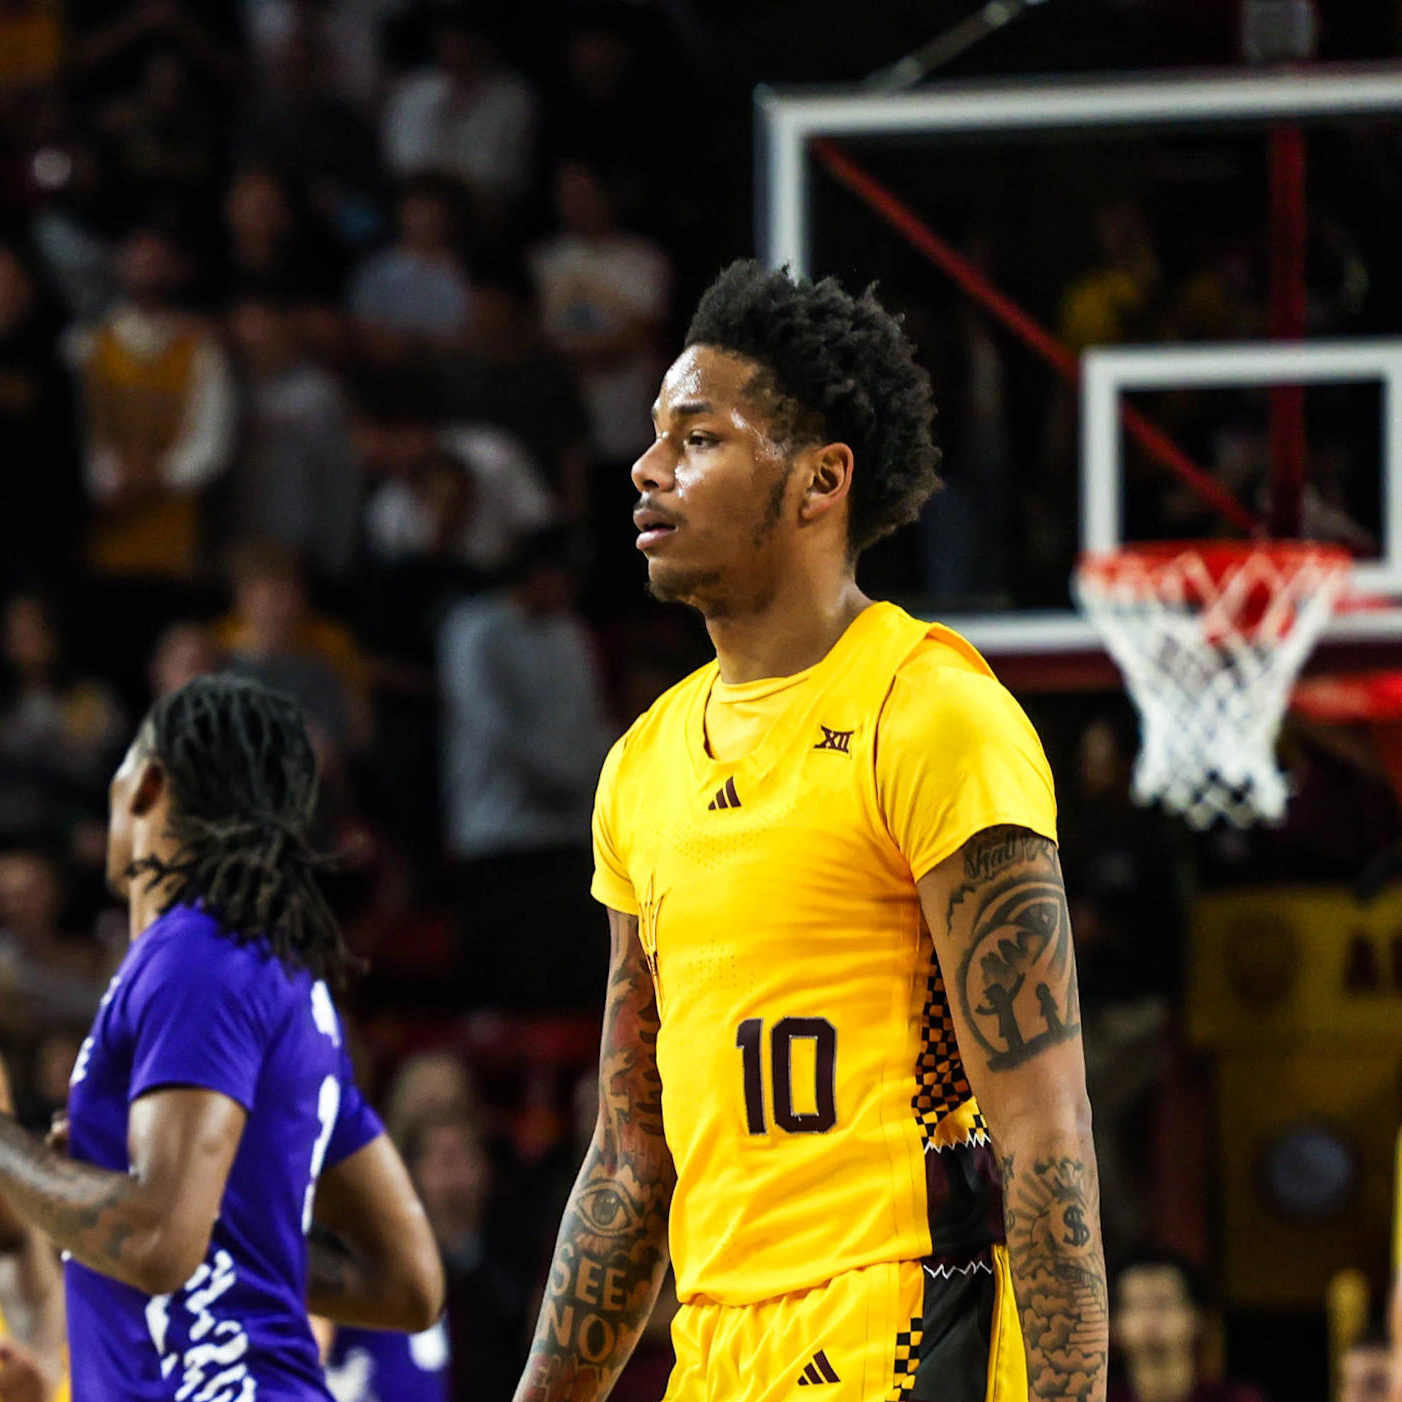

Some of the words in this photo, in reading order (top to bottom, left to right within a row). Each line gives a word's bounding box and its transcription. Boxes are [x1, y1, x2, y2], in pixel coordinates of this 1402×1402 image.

[736, 1016, 838, 1136] 10
[550, 1243, 627, 1312] SEE
[539, 1300, 615, 1363] NO
